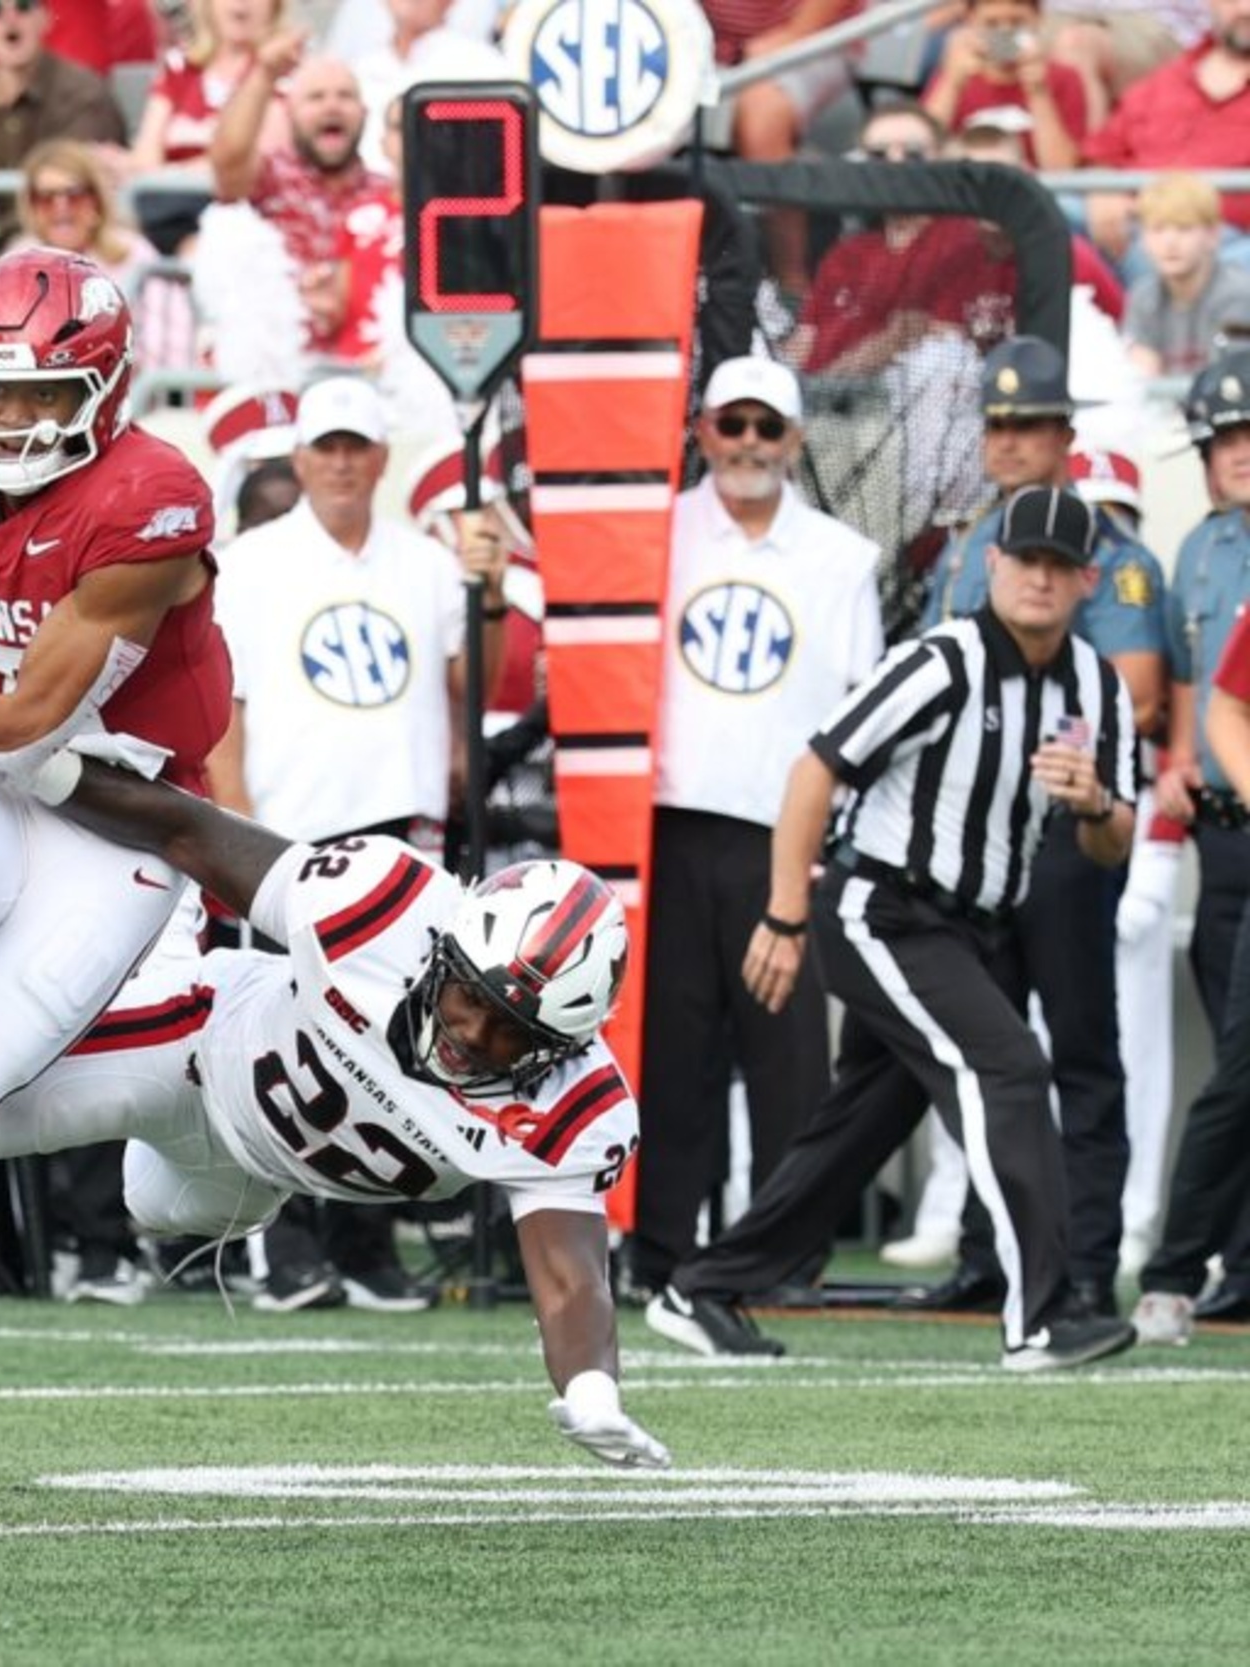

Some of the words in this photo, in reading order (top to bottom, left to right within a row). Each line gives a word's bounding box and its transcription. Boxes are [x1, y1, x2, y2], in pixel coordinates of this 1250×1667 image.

[531, 0, 667, 136] SEC
[419, 101, 523, 312] 2
[302, 604, 409, 706] SEC
[680, 584, 794, 692] SEC
[983, 705, 1000, 732] S
[253, 1030, 439, 1197] 22
[316, 1028, 398, 1114] ARKANSAS
